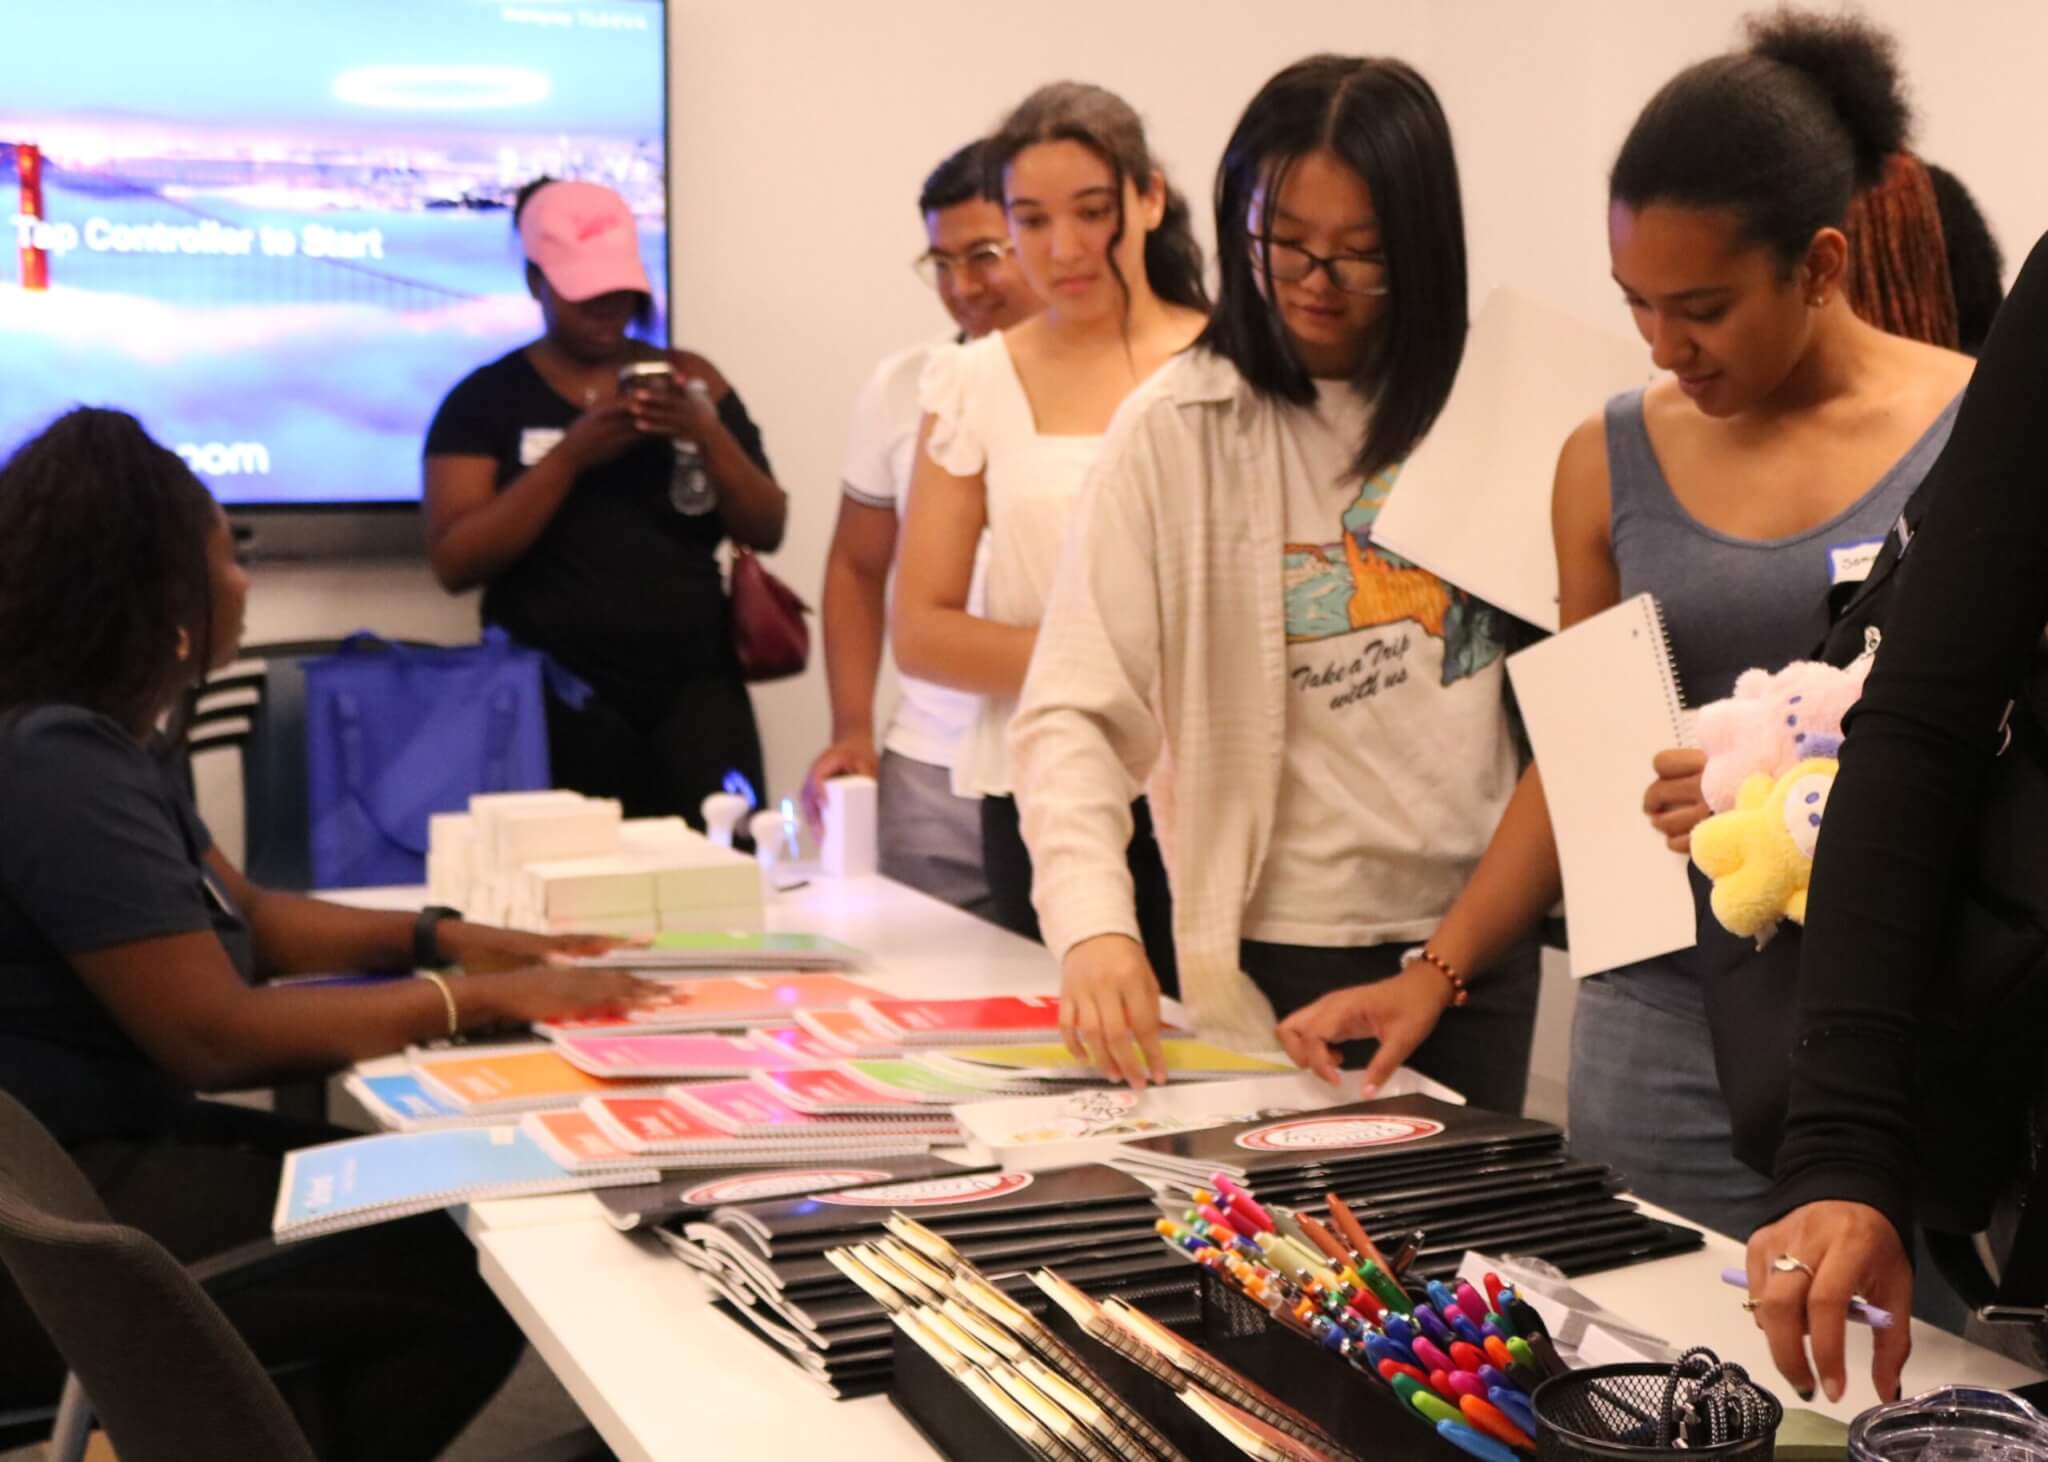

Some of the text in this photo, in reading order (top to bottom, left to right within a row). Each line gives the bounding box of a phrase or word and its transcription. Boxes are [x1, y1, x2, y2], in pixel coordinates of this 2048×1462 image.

[11, 214, 384, 259] Tap Controller to Start
[1291, 634, 1409, 692] Take a Trip
[1329, 667, 1407, 710] with us
